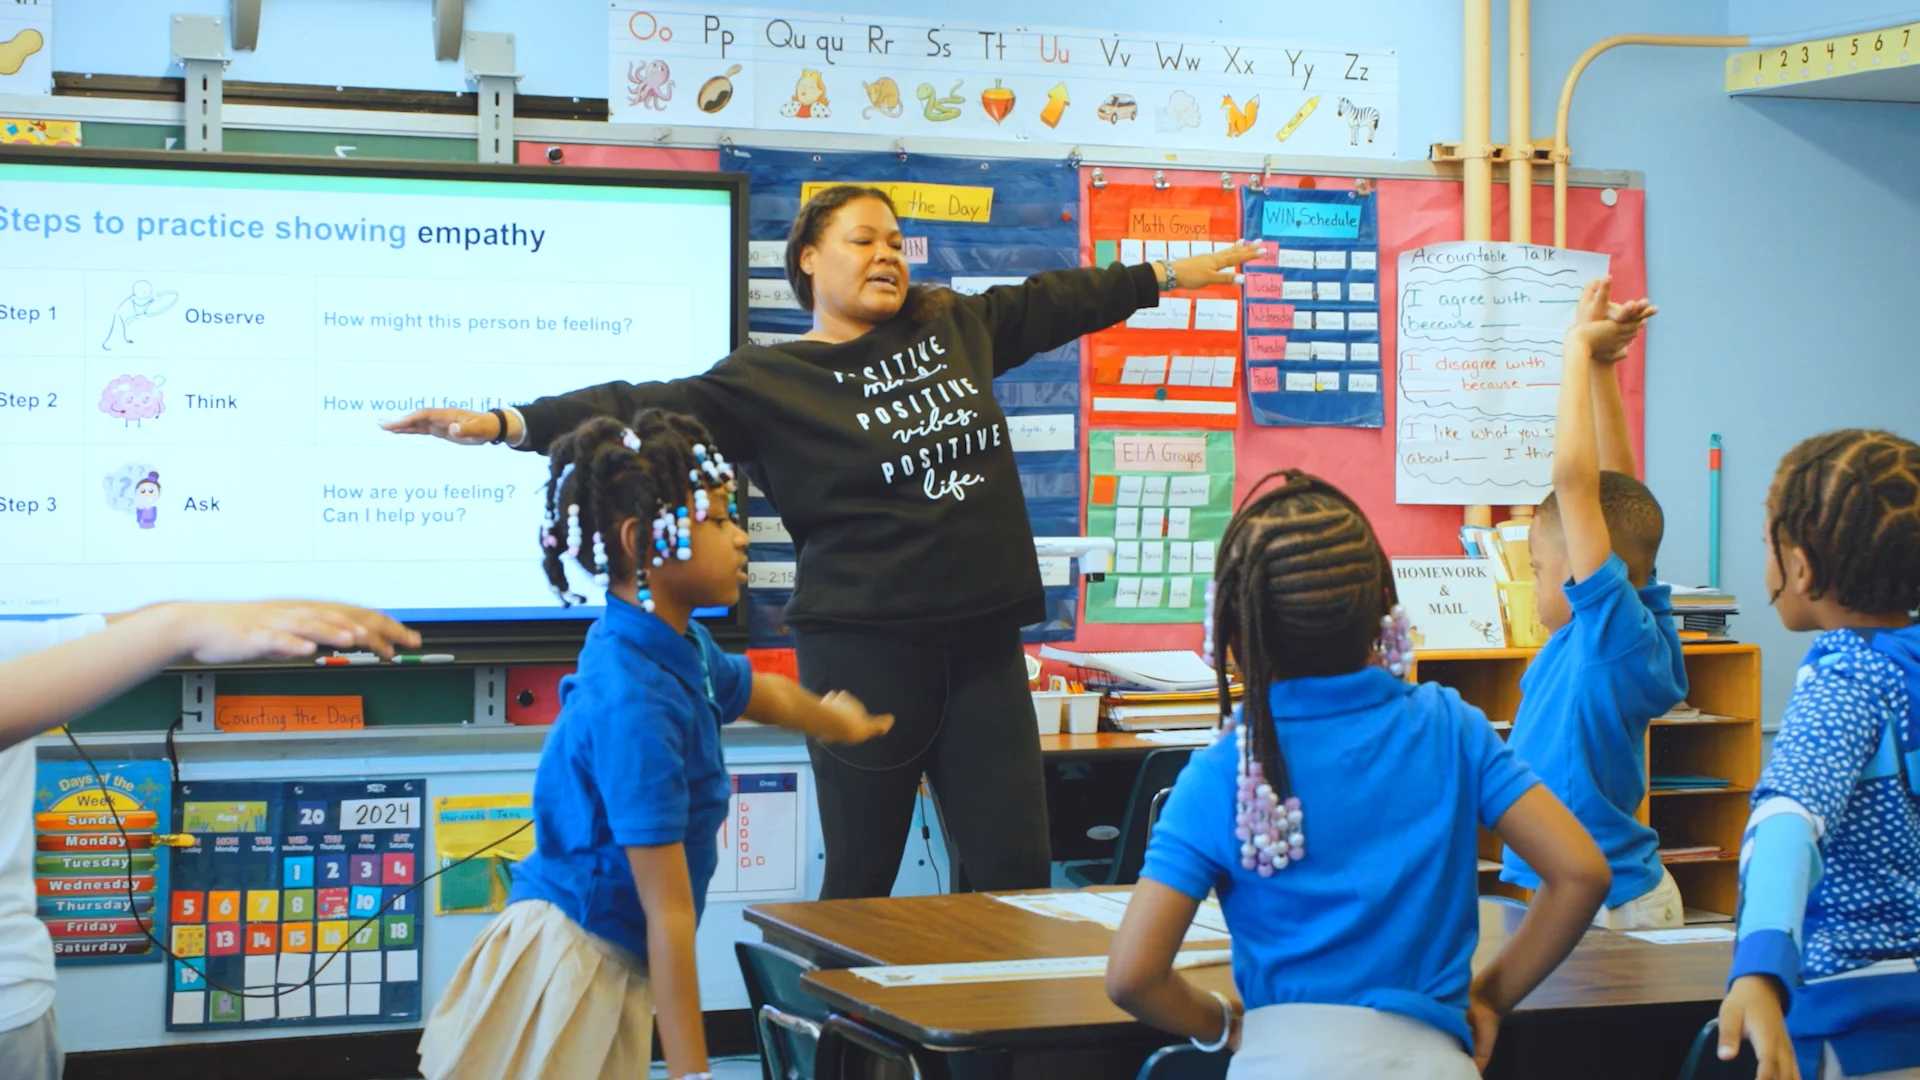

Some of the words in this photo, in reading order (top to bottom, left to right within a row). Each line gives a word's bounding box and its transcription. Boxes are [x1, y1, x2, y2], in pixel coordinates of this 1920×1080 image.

[629, 11, 673, 42] Oo
[704, 15, 735, 59] Pp
[766, 19, 806, 49] Qu
[816, 36, 844, 65] qu
[868, 25, 894, 55] Rr
[926, 28, 951, 58] Ss
[978, 31, 1007, 61] Tt
[1040, 34, 1070, 64] Uu
[1100, 38, 1131, 68] Vv
[1155, 42, 1201, 72] Ww
[1223, 46, 1255, 75] Xx
[1285, 48, 1315, 91] Yy
[1344, 53, 1369, 81] Zz
[1780, 50, 1788, 67] 2
[1801, 46, 1809, 64] 3
[1826, 42, 1834, 59] 4
[1851, 38, 1858, 56] 5
[1874, 34, 1883, 51] 6
[1903, 29, 1910, 47] 7
[909, 190, 937, 214] the
[949, 194, 991, 222] Day!
[1132, 213, 1165, 234] Math
[1169, 214, 1208, 240] Groups
[1265, 207, 1296, 225] WIN
[1299, 207, 1358, 228] Schedule
[0, 205, 82, 238] Steps
[93, 210, 125, 235] to
[137, 213, 265, 241] practice
[275, 215, 407, 249] showing
[417, 223, 546, 253] empathy
[1411, 247, 1509, 266] Accountable
[1518, 245, 1557, 262] Talk
[1406, 289, 1423, 308] I
[1438, 293, 1486, 318] agree
[1493, 291, 1532, 306] with
[0, 304, 41, 324] Step
[48, 306, 57, 321] 1
[184, 308, 266, 325] Observe
[323, 311, 365, 327] How
[370, 312, 424, 332] might
[428, 313, 462, 330] this
[468, 316, 531, 332] person
[536, 315, 558, 331] be
[563, 315, 634, 336] feeling?
[1407, 316, 1475, 332] because
[1405, 354, 1422, 371] I
[1435, 356, 1498, 379] disagree
[1506, 358, 1546, 370] with
[1461, 375, 1522, 391] because
[0, 391, 40, 412] Step
[47, 392, 58, 408] 2
[184, 393, 238, 410] Think
[323, 396, 364, 411] How
[370, 397, 425, 411] would
[443, 397, 474, 410] feel
[480, 397, 492, 412] if
[856, 377, 979, 431] POSITIVE
[892, 406, 978, 444] vibes.
[1406, 422, 1422, 440] I
[1433, 424, 1462, 441] like
[1471, 427, 1510, 440] what
[1518, 428, 1540, 445] you
[881, 423, 1001, 484] POSITIVE
[1122, 442, 1157, 463] ELA
[1161, 442, 1203, 470] Groups
[1406, 449, 1451, 466] about
[1503, 447, 1517, 460] I
[1525, 445, 1555, 460] thin
[322, 484, 364, 499] How
[369, 487, 399, 499] are
[404, 487, 438, 503] you
[444, 484, 516, 503] feeling?
[923, 467, 985, 501] life.
[0, 496, 40, 516] Step
[47, 496, 58, 512] 3
[184, 496, 221, 512] Ask
[322, 507, 359, 523] Can
[376, 508, 416, 526] help
[421, 507, 467, 526] you?
[769, 571, 795, 583] 2:15
[1396, 565, 1488, 580] HOMEWORK
[1439, 584, 1451, 598] &
[1428, 602, 1468, 616] MAIL
[217, 705, 287, 731] Counting
[294, 705, 318, 725] the
[327, 705, 362, 729] Days
[58, 774, 94, 792] Days
[112, 775, 136, 792] the
[77, 795, 116, 807] Week
[67, 815, 126, 827] Sunday
[300, 808, 325, 825] 20
[355, 802, 409, 826] 2024
[441, 811, 486, 821] Hundreds
[495, 809, 521, 819] Tens
[65, 836, 127, 848] Monday
[62, 857, 130, 869] Tuesday
[293, 865, 301, 881] 1
[326, 862, 341, 879] 2
[360, 861, 373, 878] 3
[392, 861, 407, 877] 4
[49, 879, 140, 891] Wednesday
[56, 900, 132, 912] Thursday
[183, 899, 195, 916] 5
[219, 898, 233, 915] 6
[258, 898, 271, 914] 7
[291, 897, 304, 914] 8
[355, 894, 376, 911] 10
[392, 894, 406, 911] 11
[66, 921, 117, 933] Friday
[215, 930, 235, 948] 13
[252, 932, 271, 948] 14
[288, 929, 307, 947] 15
[323, 929, 342, 946] 16
[355, 927, 373, 944] 17
[390, 922, 409, 939] 18
[54, 942, 127, 954] Saturday
